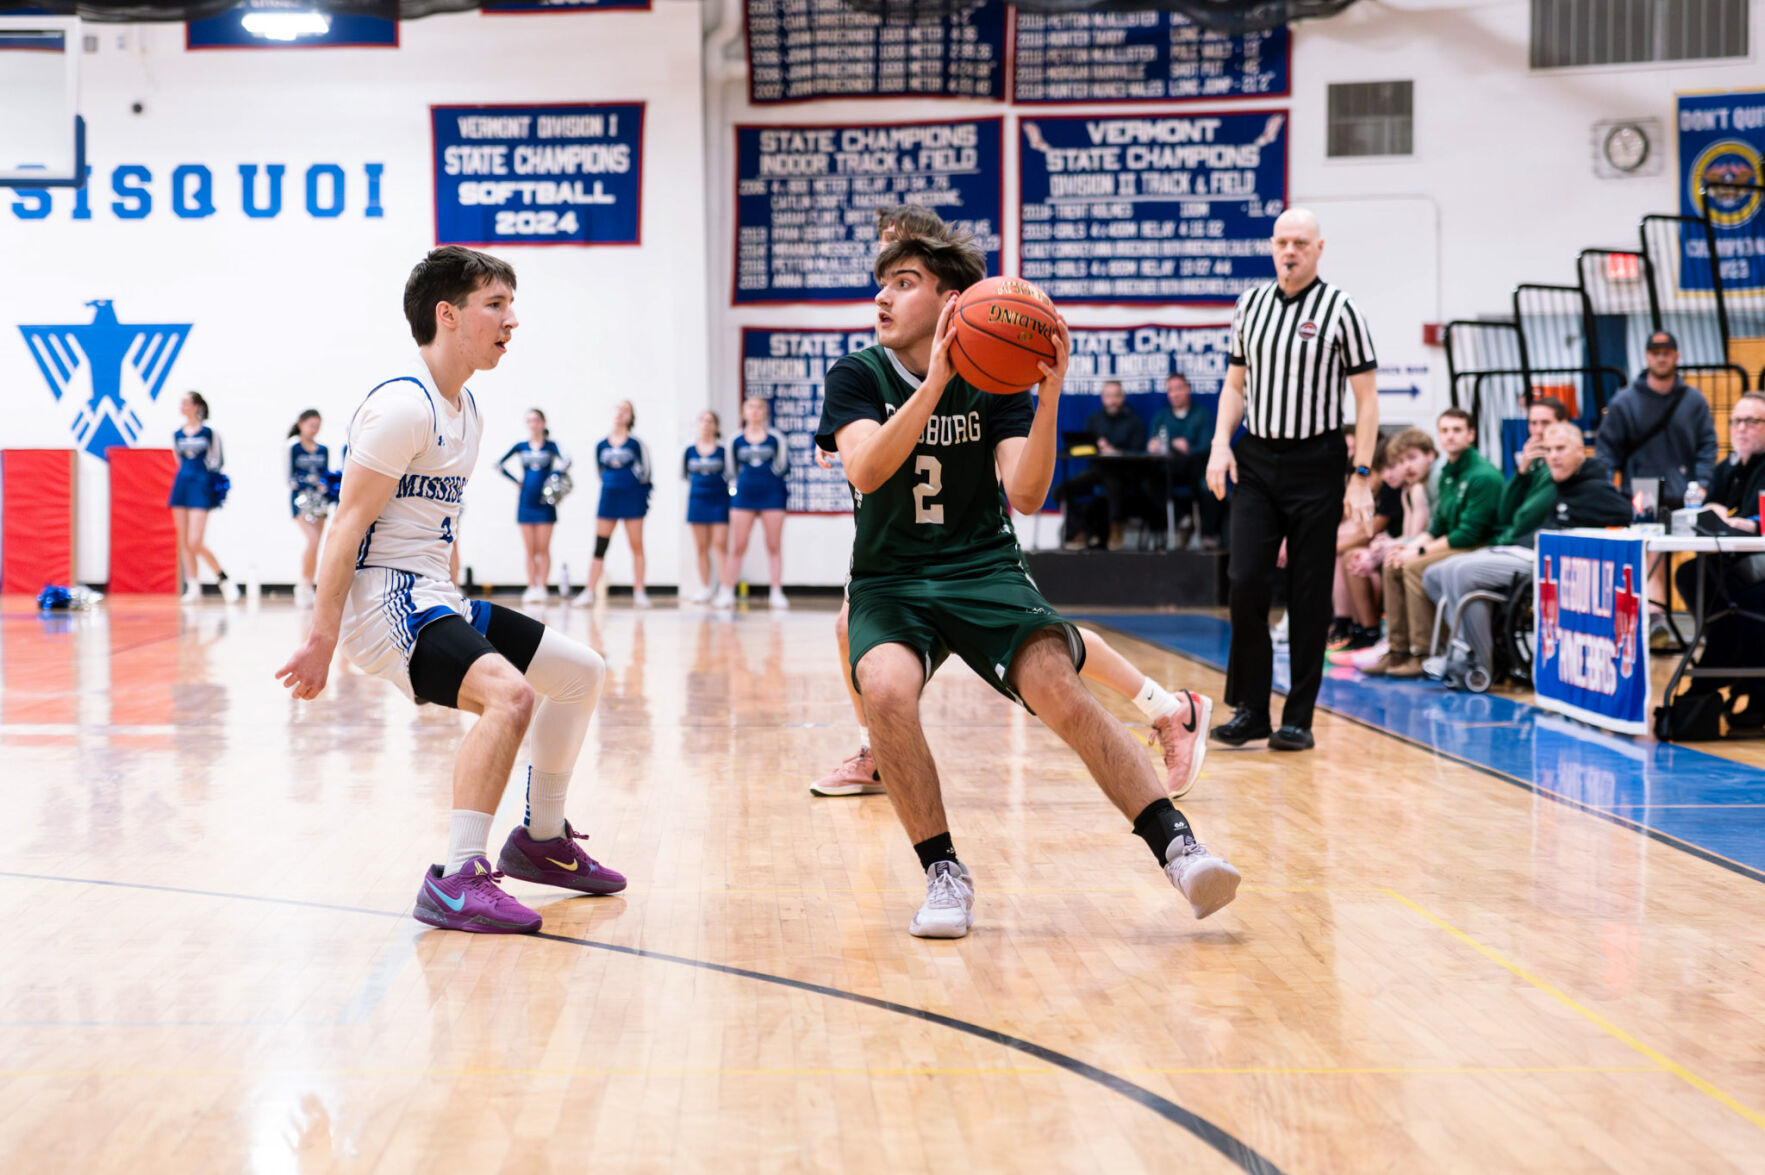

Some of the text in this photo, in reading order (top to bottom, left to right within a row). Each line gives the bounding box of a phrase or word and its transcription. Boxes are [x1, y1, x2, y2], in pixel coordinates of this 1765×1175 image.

[457, 115, 532, 139] VERMONT
[537, 114, 604, 138] DIVISION
[759, 124, 978, 153] STATE CHAMPIONS
[1086, 118, 1222, 145] VERMONT
[444, 143, 630, 175] STATE CHAMPIONS
[760, 152, 829, 175] INDOOR
[834, 150, 899, 172] TRACK
[918, 148, 978, 171] FIELD
[1045, 144, 1260, 172] STATE CHAMPIONS
[458, 181, 616, 205] SOFTBALL
[1049, 173, 1115, 196] DIVISION
[1141, 171, 1191, 194] TRACK
[1210, 170, 1256, 193] FIELD
[495, 211, 579, 234] 2024
[988, 304, 1056, 340] PALDING
[769, 333, 844, 357] STATE
[1068, 332, 1130, 354] TATE
[912, 454, 945, 524] 2
